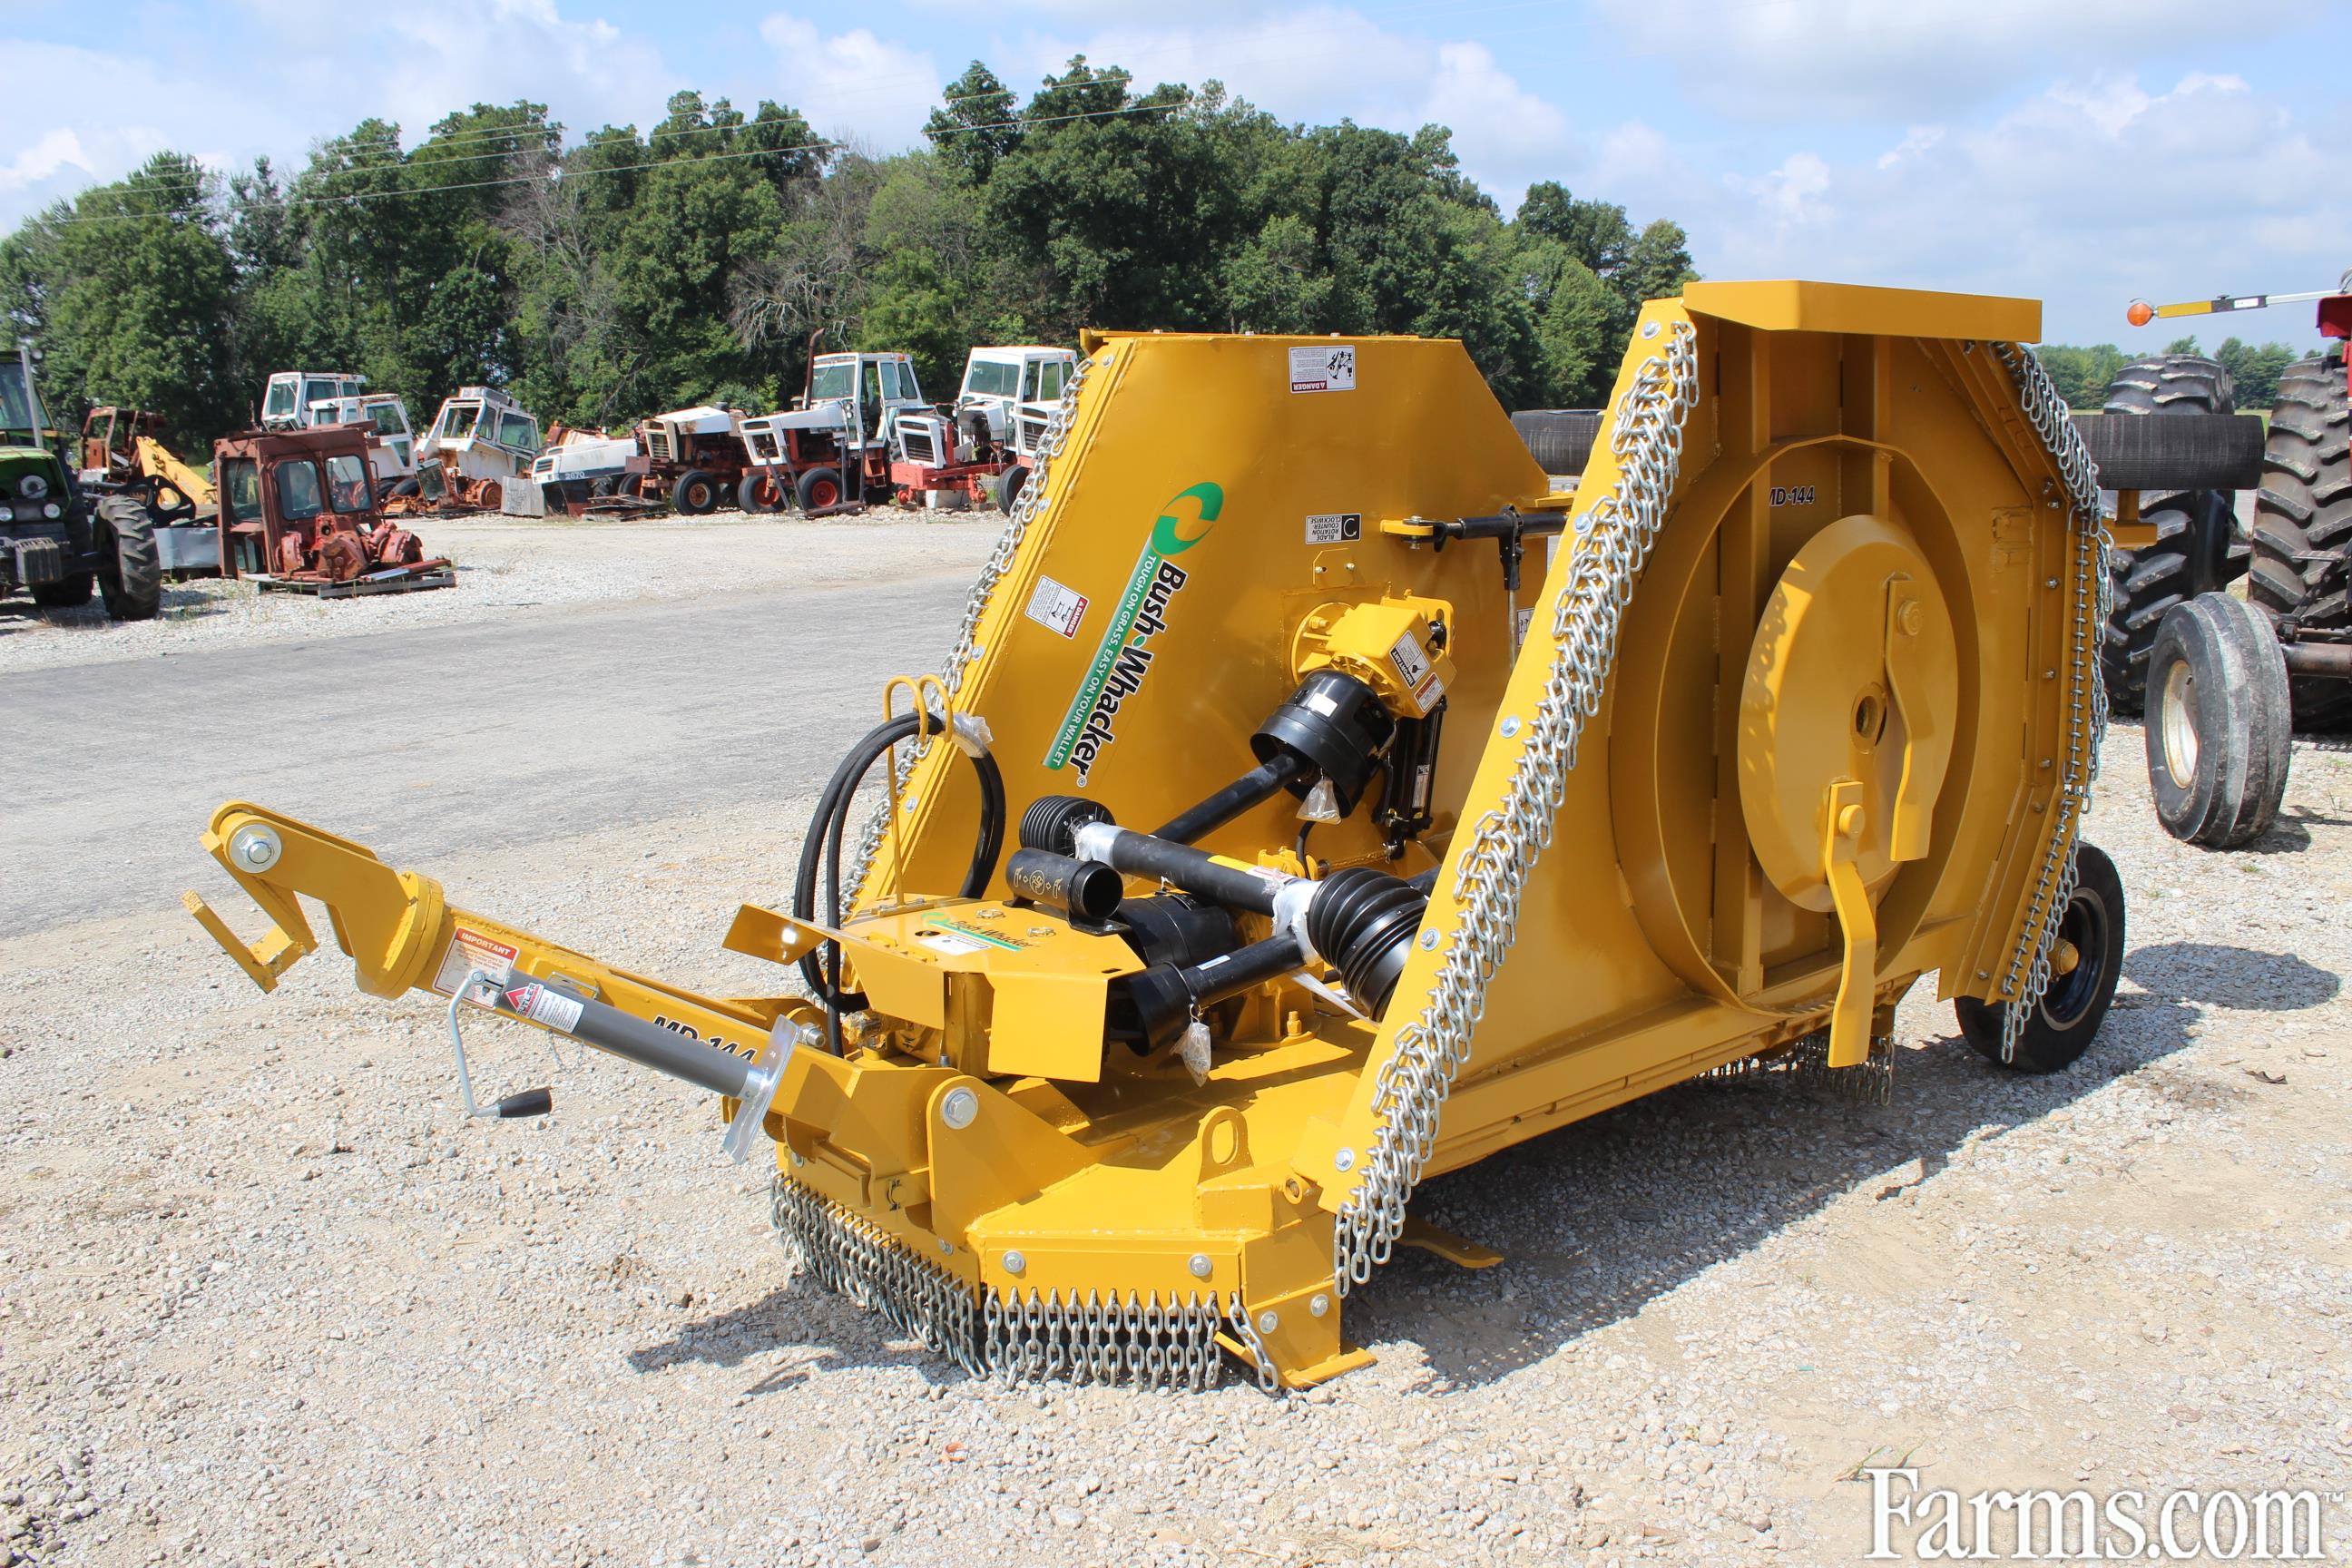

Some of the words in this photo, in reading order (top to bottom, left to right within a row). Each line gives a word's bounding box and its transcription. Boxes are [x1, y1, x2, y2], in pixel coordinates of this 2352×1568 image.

[1135, 555, 1157, 593] TOUGH
[1126, 593, 1139, 610] ON
[1066, 606, 1083, 633] DANGER
[1108, 610, 1131, 647] GRASS,
[1094, 649, 1114, 678] EASY
[1392, 650, 1414, 685] IMPORTANT
[1087, 677, 1100, 694] ON
[1072, 694, 1093, 723] YOUR
[1053, 724, 1078, 767] WALLET
[461, 932, 511, 956] IMPORTANT
[652, 1014, 758, 1064] MD144
